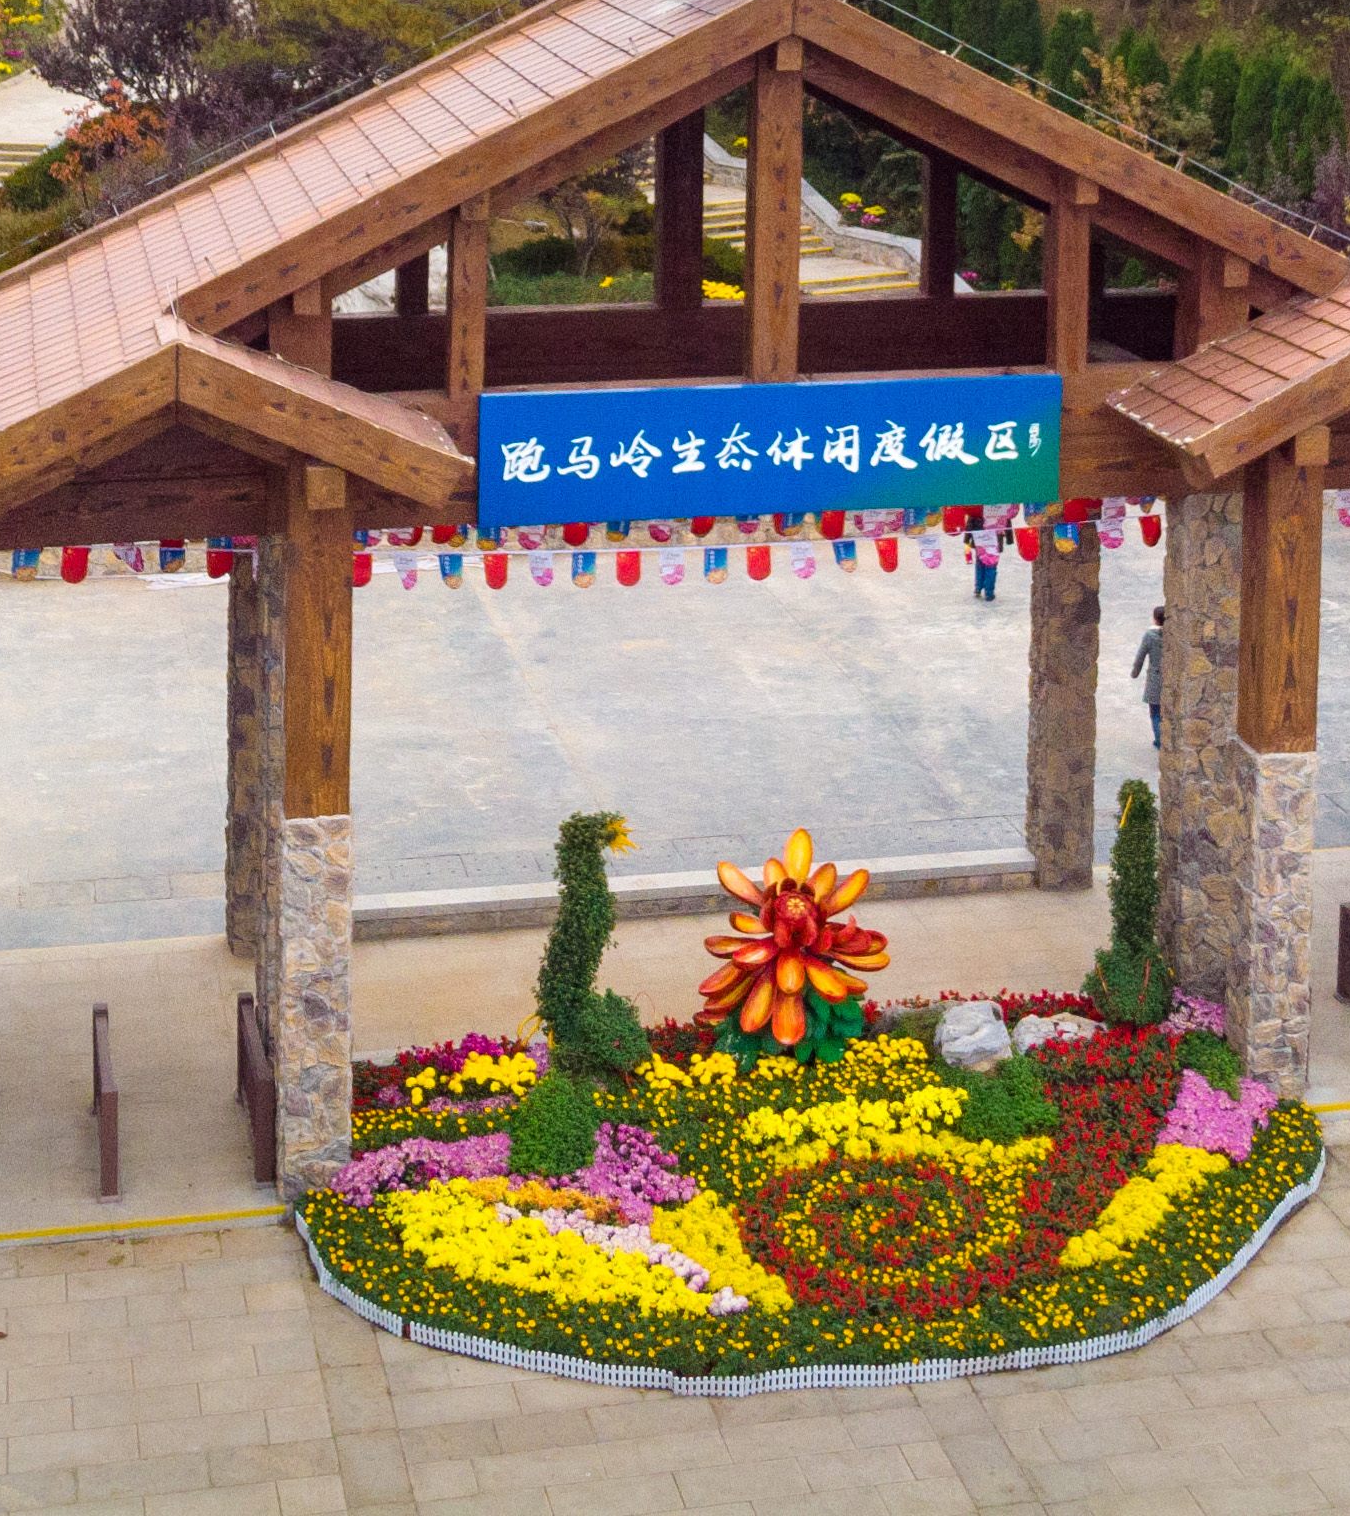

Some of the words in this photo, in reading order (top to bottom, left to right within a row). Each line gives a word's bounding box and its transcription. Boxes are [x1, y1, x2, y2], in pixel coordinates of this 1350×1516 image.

[502, 420, 1019, 482] 跑马岭生态休闲度假区
